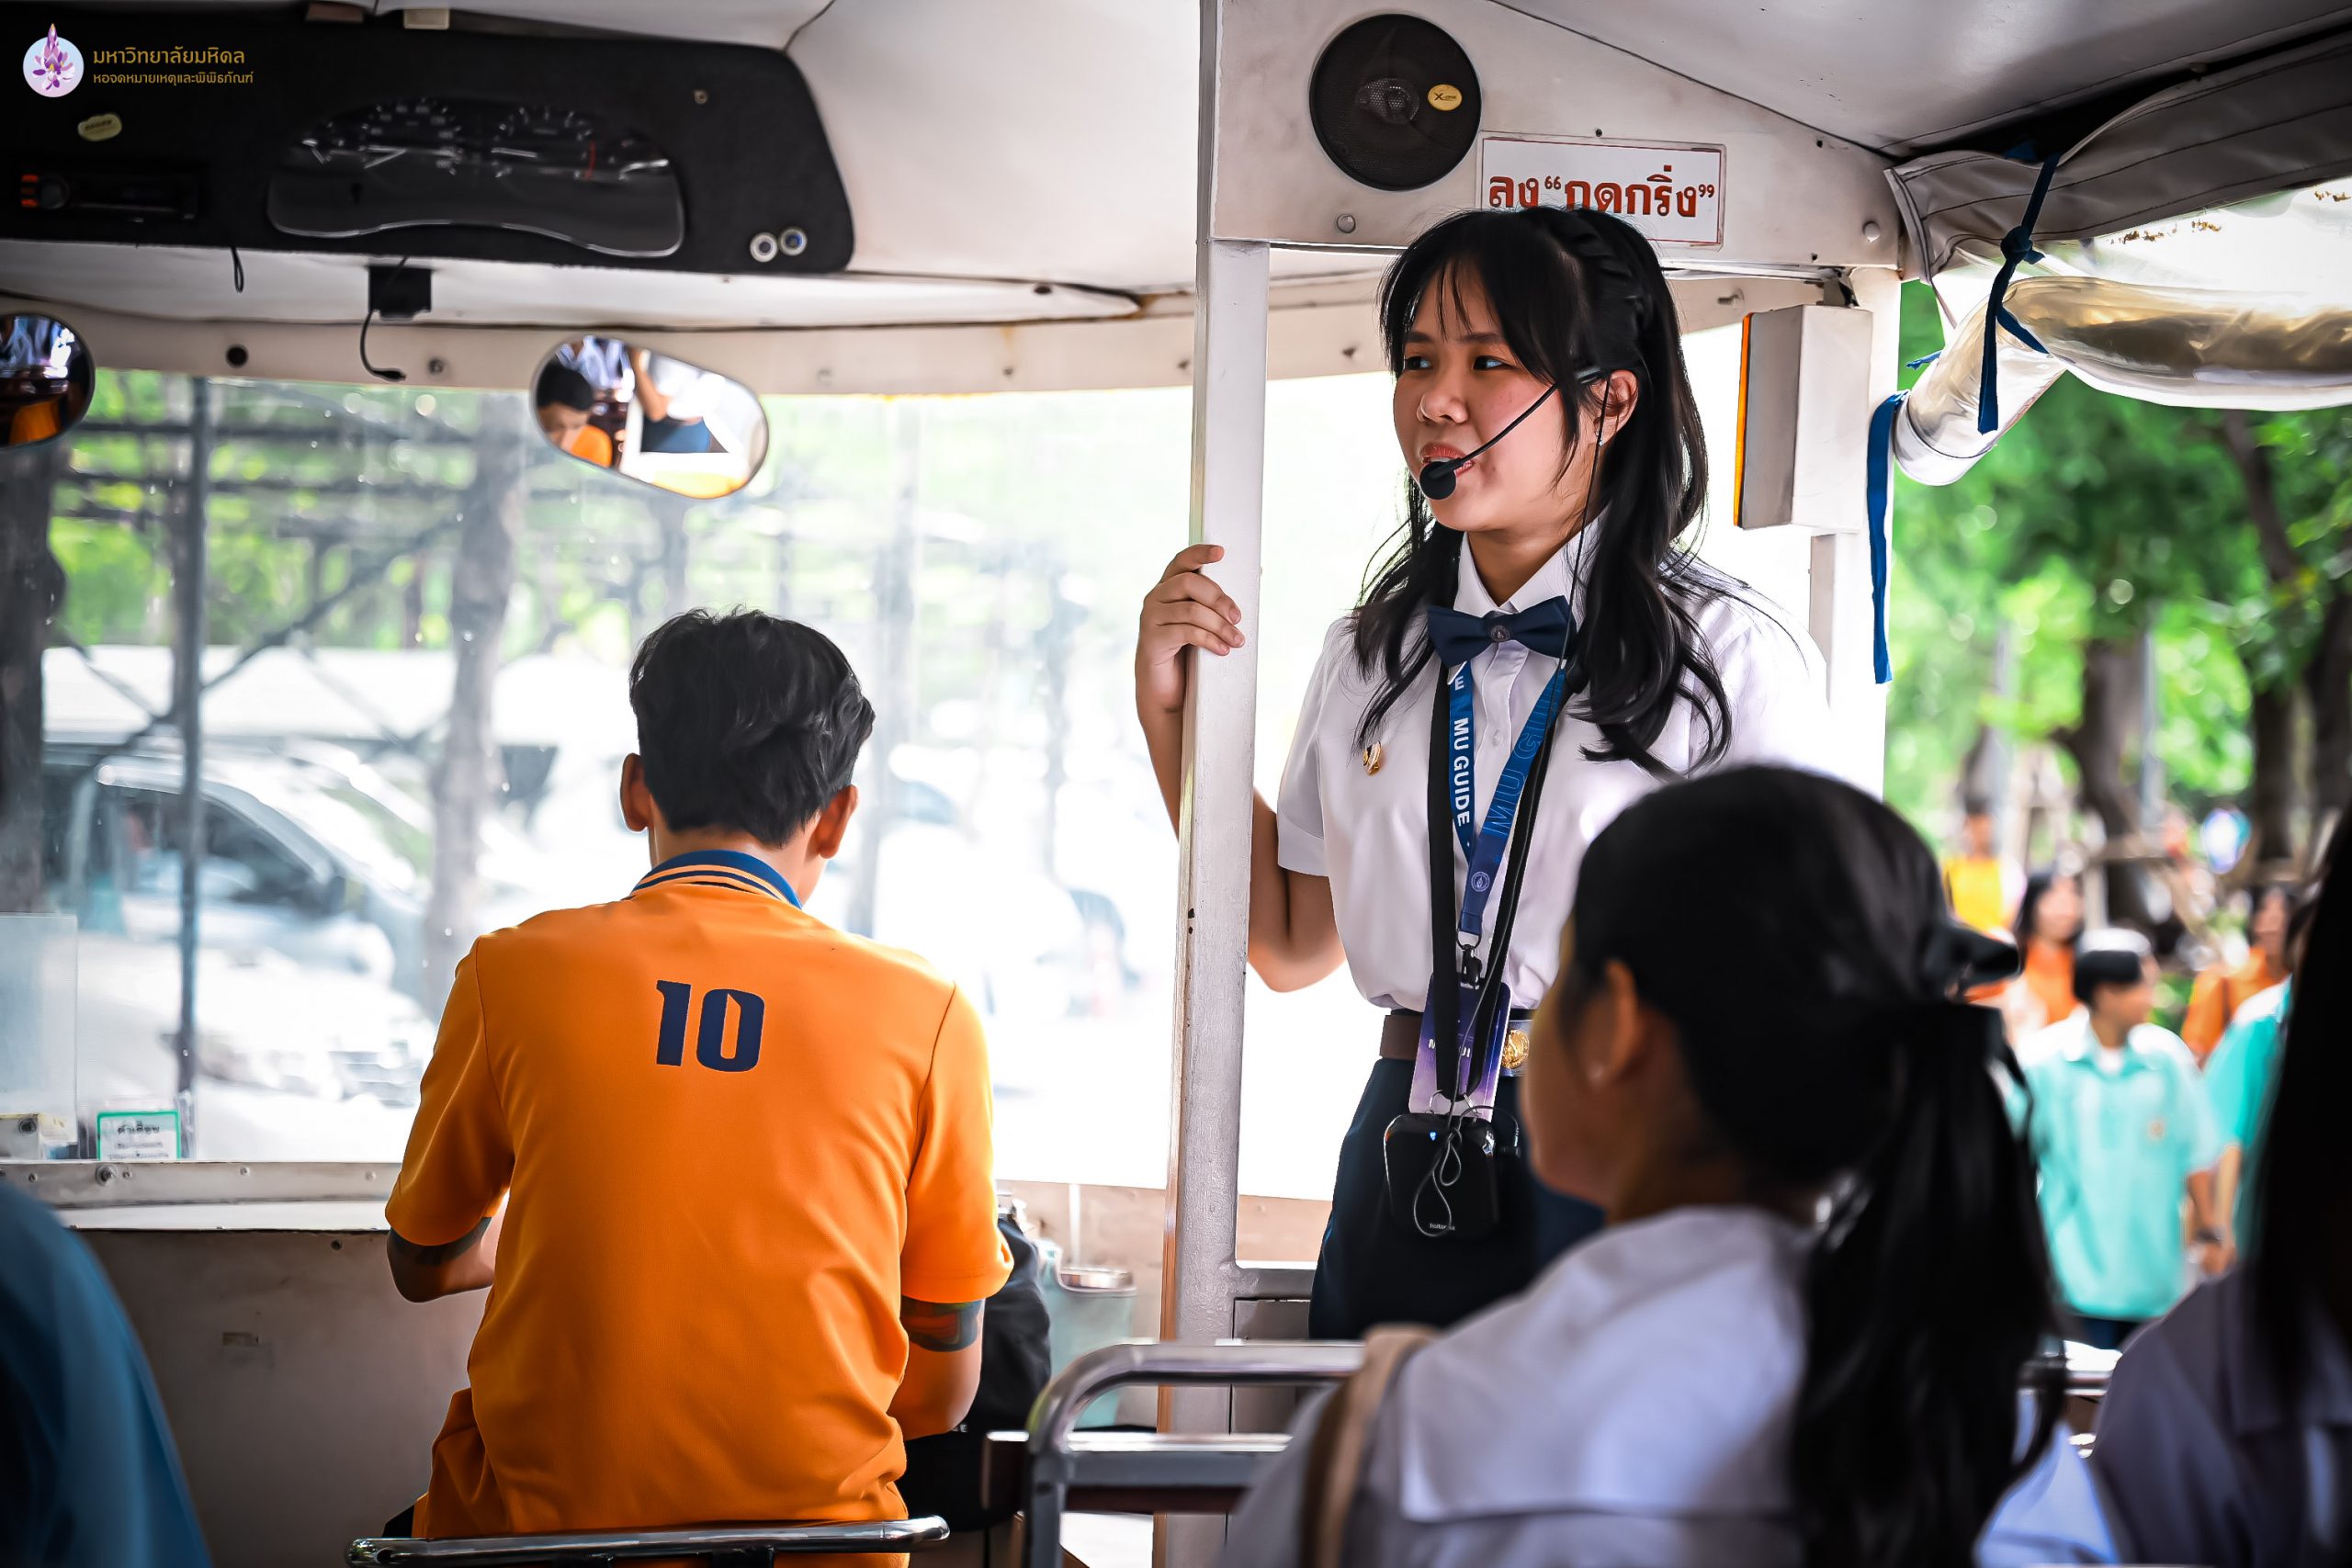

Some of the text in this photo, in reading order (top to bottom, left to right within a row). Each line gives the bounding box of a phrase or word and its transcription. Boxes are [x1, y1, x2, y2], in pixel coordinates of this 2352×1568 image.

[1453, 717, 1470, 827] MU GUIDE
[656, 979, 765, 1073] 10
